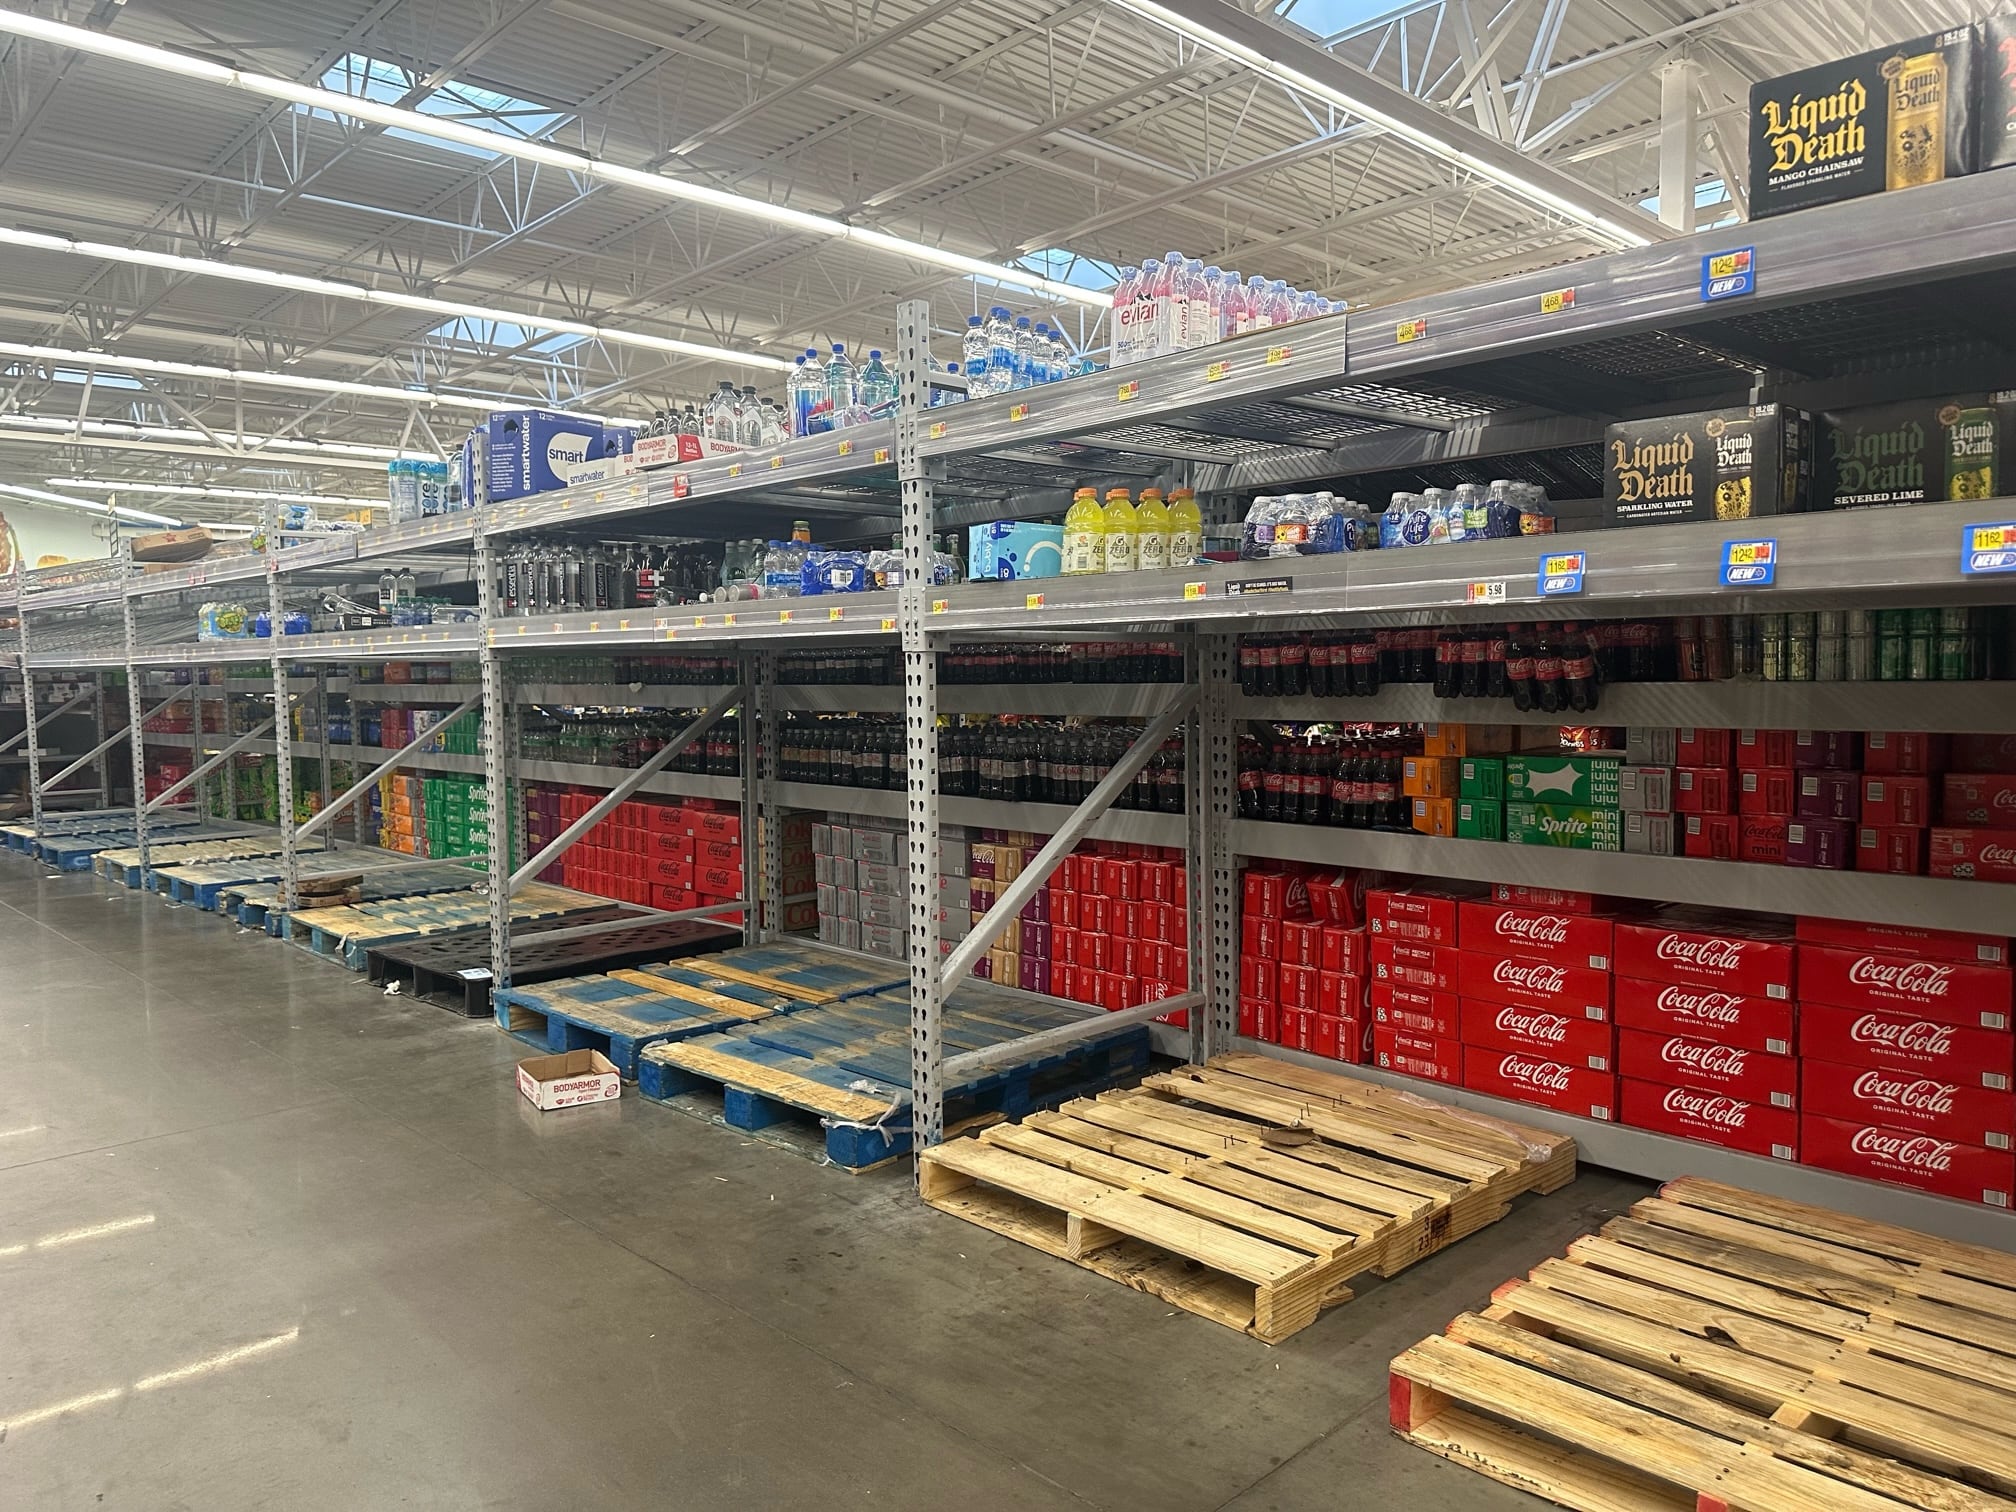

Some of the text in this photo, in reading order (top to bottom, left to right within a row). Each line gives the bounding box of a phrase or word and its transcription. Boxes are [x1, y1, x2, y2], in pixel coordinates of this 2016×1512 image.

[1894, 68, 1941, 94] Liquid
[1761, 79, 1866, 138] Liquid
[1895, 90, 1940, 111] Death
[1769, 117, 1865, 172] Death
[1768, 156, 1864, 185] MANGO CHAINSAW
[1710, 279, 1734, 294] NEW
[1121, 303, 1159, 325] evian
[1180, 306, 1188, 340] evian
[1951, 421, 1993, 441] Liquid
[638, 439, 666, 451] BODYARMOR
[1716, 433, 1752, 451] Liquid
[1828, 421, 1924, 463] Liquid
[1952, 439, 1993, 456] Death
[521, 415, 530, 491] smartwater
[549, 448, 583, 463] smart
[1611, 431, 1695, 476] Liquid
[1717, 450, 1752, 466] Death
[570, 470, 605, 484] smartwater
[1617, 464, 1694, 501] Death
[1834, 454, 1924, 494] Death
[1834, 493, 1889, 505] SEVERED
[1892, 490, 1924, 500] LIME
[1616, 500, 1693, 513] SPARKLING WATER
[984, 542, 992, 572] bubly
[1109, 546, 1130, 554] ZERO
[1974, 555, 2004, 566] NEW
[1730, 568, 1754, 580] NEW
[1488, 585, 1502, 595] 5.98
[1546, 578, 1566, 589] NEW
[1591, 809, 1620, 821] mini
[1539, 816, 1587, 835] Sprite
[1591, 820, 1620, 830] mini
[1591, 830, 1620, 841] mini
[1591, 840, 1620, 851] mini
[1751, 845, 1780, 856] mini
[1495, 910, 1571, 943] Coca-Cola
[1866, 926, 1903, 936] ORIGINAL
[1509, 938, 1535, 947] ORIGINAL
[1656, 933, 1745, 969] Coca-Cola
[1493, 959, 1568, 993] Coca-Cola
[1674, 964, 1703, 973] ORIGINAL
[1850, 956, 1955, 996] Coca-Cola
[1507, 987, 1532, 995] ORIGINAL
[1868, 990, 1930, 1003] ORIGINAL TASTE
[1657, 986, 1745, 1023] Coca-Cola
[1496, 1007, 1572, 1042] Coca-Cola
[1673, 1016, 1704, 1026] ORIGINAL
[1509, 1035, 1534, 1044] ORIGINAL
[1851, 1014, 1958, 1055] Coca-Cola
[1661, 1037, 1750, 1076] Coca-Cola
[1870, 1047, 1933, 1062] ORIGINAL TASTE
[1499, 1054, 1574, 1091] Coca-Cola
[1678, 1067, 1729, 1081] ORIGINAL TASTE
[554, 1079, 600, 1093] BODYARMOR
[1513, 1082, 1556, 1096] ORIGINAL TASTE
[1853, 1071, 1960, 1114] Coca-Cola
[1663, 1087, 1751, 1127] Coca-Cola
[1872, 1104, 1935, 1121] ORIGINAL TASTE
[1679, 1117, 1731, 1133] ORIGINAL TASTE
[1851, 1127, 1958, 1171] Coca-Cola
[1871, 1160, 1934, 1177] ORIGINAL TASTE
